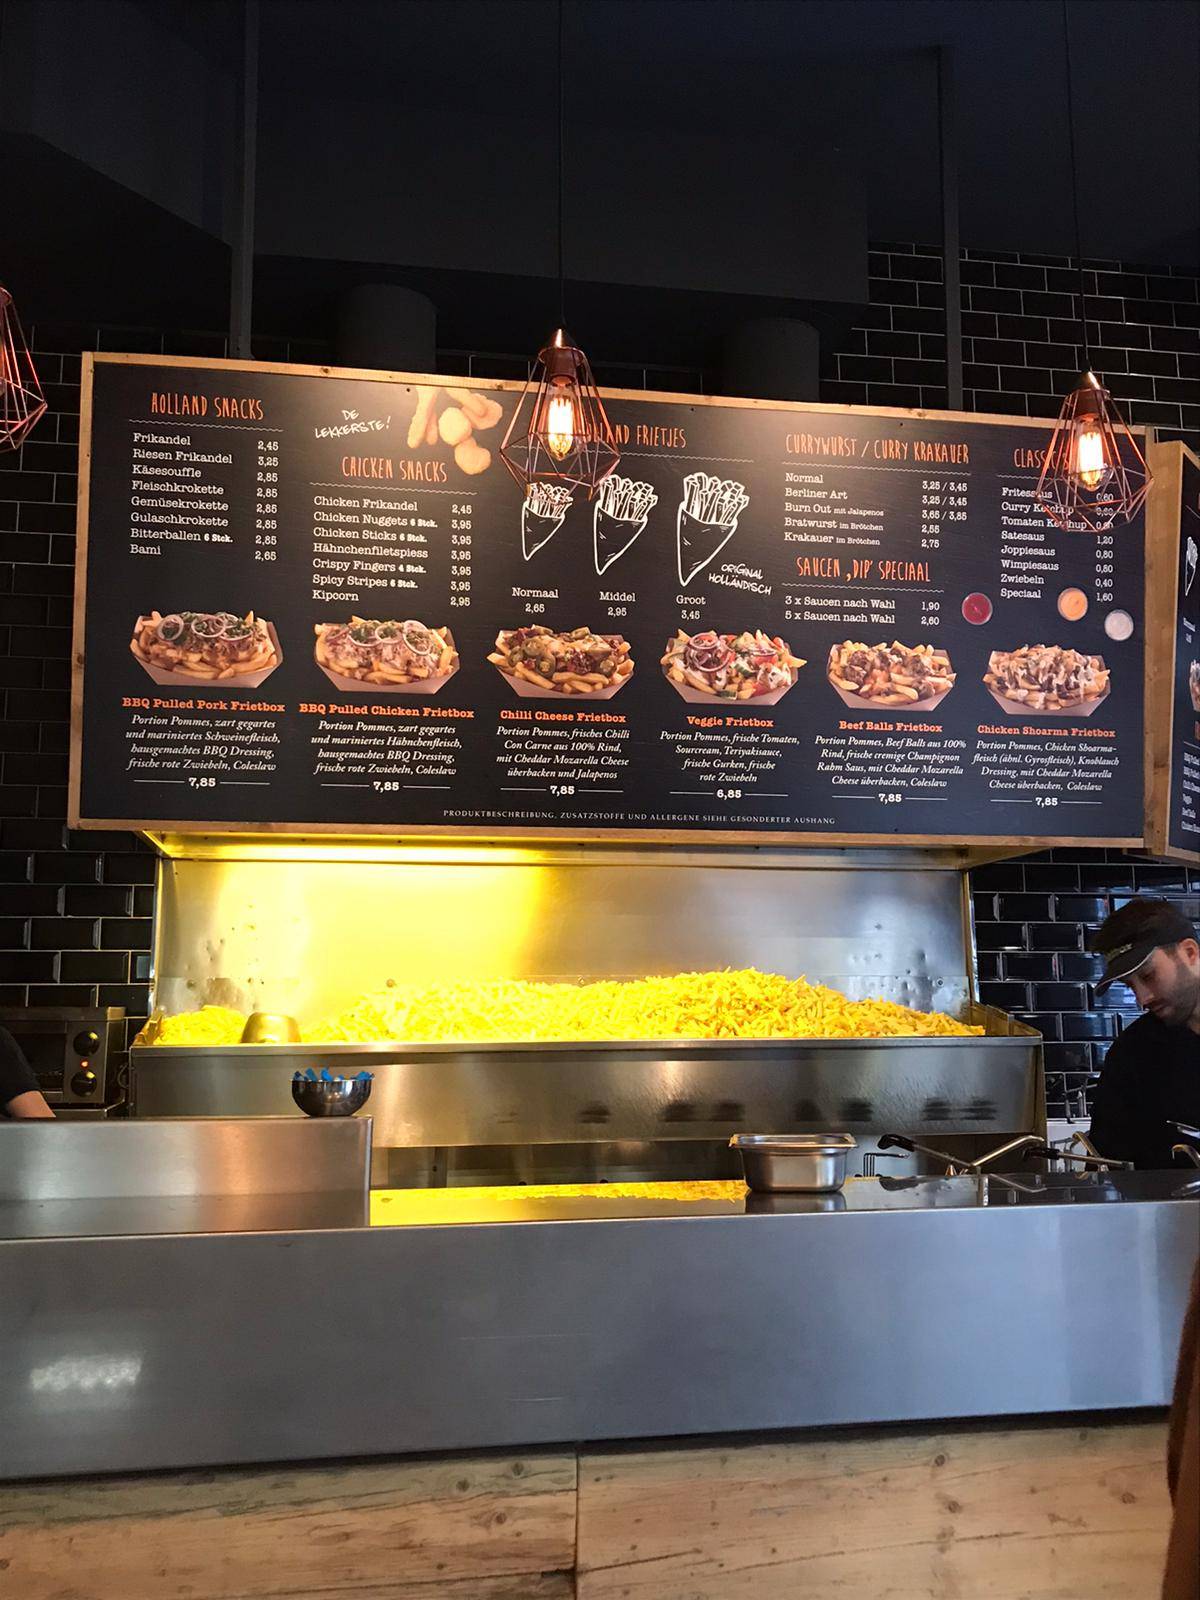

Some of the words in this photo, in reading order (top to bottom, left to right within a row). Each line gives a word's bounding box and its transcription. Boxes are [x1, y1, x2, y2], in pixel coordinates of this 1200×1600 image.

[152, 393, 208, 416] HOLLAND
[214, 397, 264, 420] SNACKS
[342, 409, 359, 420] DE
[315, 416, 392, 439] LEKKERSTE!
[133, 433, 191, 445] Frikandel
[637, 425, 687, 448] FRIETJES
[257, 441, 278, 451] 2,45
[786, 434, 857, 457] CURRYWURST
[874, 440, 908, 459] CURRY
[914, 443, 969, 464] KRAKAUER
[133, 449, 172, 460] Riesen
[176, 452, 232, 464] Frikandel
[258, 457, 278, 467] 3,25
[132, 465, 201, 477] Käsesouffle
[342, 456, 393, 478] CHICKEN
[400, 460, 448, 483] SNACKS
[257, 473, 278, 483] 2,85
[785, 473, 824, 484] Normal
[132, 480, 224, 494] Fleischkrokette
[922, 481, 940, 490] 3,25
[950, 482, 967, 492] 3,45
[257, 489, 278, 498] 2,85
[785, 488, 827, 499] Berliner
[829, 490, 848, 499] Art
[131, 496, 229, 511] Gemüsekrokette
[314, 496, 360, 508] Chicken
[363, 499, 418, 511] Frikandel
[922, 496, 940, 505] 3,25
[949, 497, 967, 506] 3,45
[256, 504, 277, 514] 2,85
[452, 505, 472, 514] 2,45
[785, 503, 811, 513] Burn
[813, 505, 832, 514] Out
[1002, 502, 1031, 514] Curry
[131, 513, 229, 527] Gulaschkrokette
[314, 512, 359, 523] Chicken
[362, 515, 408, 527] Nuggets
[922, 510, 940, 519] 3,65
[949, 511, 967, 521] 3,85
[256, 520, 277, 530] 2,85
[452, 520, 472, 530] 3,95
[785, 517, 837, 529] Bratwurst
[1001, 516, 1044, 527] Tomaten
[131, 528, 201, 541] Bitterballen
[313, 527, 359, 539] Chicken
[362, 530, 397, 541] Sticks
[922, 525, 939, 534] 2,55
[255, 536, 277, 545] 2,85
[452, 535, 472, 545] 3,95
[784, 532, 834, 543] Krakauer
[1001, 531, 1044, 541] Satesaus
[1097, 536, 1113, 545] 1,20
[130, 544, 161, 555] Bami
[921, 539, 939, 549] 2,75
[255, 552, 276, 561] 2,65
[313, 543, 428, 559] Hähnchenfiletspiess
[1001, 545, 1056, 557] Joppiesaus
[1096, 550, 1113, 560] 0,80
[313, 559, 350, 572] Crispy
[353, 560, 396, 573] Fingers
[796, 557, 840, 578] SAUCEN
[879, 561, 931, 582] SPECIAAL
[1001, 560, 1059, 571] Wimpiesaus
[1096, 564, 1113, 574] 0,80
[313, 574, 344, 586] Spicy
[347, 576, 388, 589] Stripes
[1001, 574, 1044, 584] Zwiebeln
[1095, 578, 1113, 588] 0,40
[312, 590, 359, 602] Kipcorn
[512, 587, 559, 599] Normaal
[600, 592, 636, 602] Middel
[1001, 588, 1041, 599] Speciaal
[1096, 593, 1113, 602] 1,60
[451, 597, 470, 607] 2,95
[676, 595, 706, 605] Groot
[785, 595, 792, 604] 3
[804, 597, 841, 607] Saucen
[843, 598, 868, 608] nach
[870, 599, 895, 609] Wahl
[525, 603, 545, 613] 2,65
[608, 607, 627, 617] 2,95
[922, 602, 940, 611] 1,90
[681, 610, 700, 620] 3,45
[785, 610, 792, 619] 5
[804, 612, 840, 621] Saucen
[843, 613, 868, 622] nach
[870, 614, 895, 624] Wahl
[921, 616, 939, 626] 2,60
[122, 698, 150, 708] BBQ
[153, 699, 193, 709] Pulled
[197, 700, 227, 710] Pork
[231, 702, 285, 712] Frietbox
[300, 704, 326, 715] BBQ
[329, 705, 368, 715] Pulled
[371, 706, 420, 716] Chicken
[423, 708, 474, 718] Frietbox
[501, 710, 532, 720] Chilli
[535, 712, 574, 721] Cheese
[577, 713, 626, 723] Frietbox
[132, 715, 168, 725] Portion
[171, 717, 213, 727] Pommes,
[237, 720, 275, 730] gegartes
[687, 716, 723, 727] Veggie
[726, 717, 773, 727] Frietbox
[839, 721, 863, 730] Beef
[866, 722, 893, 731] Balls
[896, 723, 943, 733] Frietbox
[977, 725, 1020, 734] Chicken
[1023, 726, 1068, 736] Shoarma
[1071, 728, 1116, 737] Frietbox
[676, 745, 722, 756] Sourcream,
[724, 746, 782, 758] Teriyakisauce,
[508, 768, 556, 777] überbacken
[558, 770, 575, 778] und
[188, 777, 216, 789] 7,85
[373, 782, 399, 792] 7,85
[832, 776, 859, 785] Cheese
[861, 776, 909, 787] überbacken,
[911, 778, 947, 787] Coleslaw
[550, 786, 575, 796] 7,85
[717, 790, 742, 800] 6,85
[878, 794, 902, 804] 7,85
[1035, 797, 1058, 807] 7,85
[560, 812, 625, 820] ZUSATZSTOFFE
